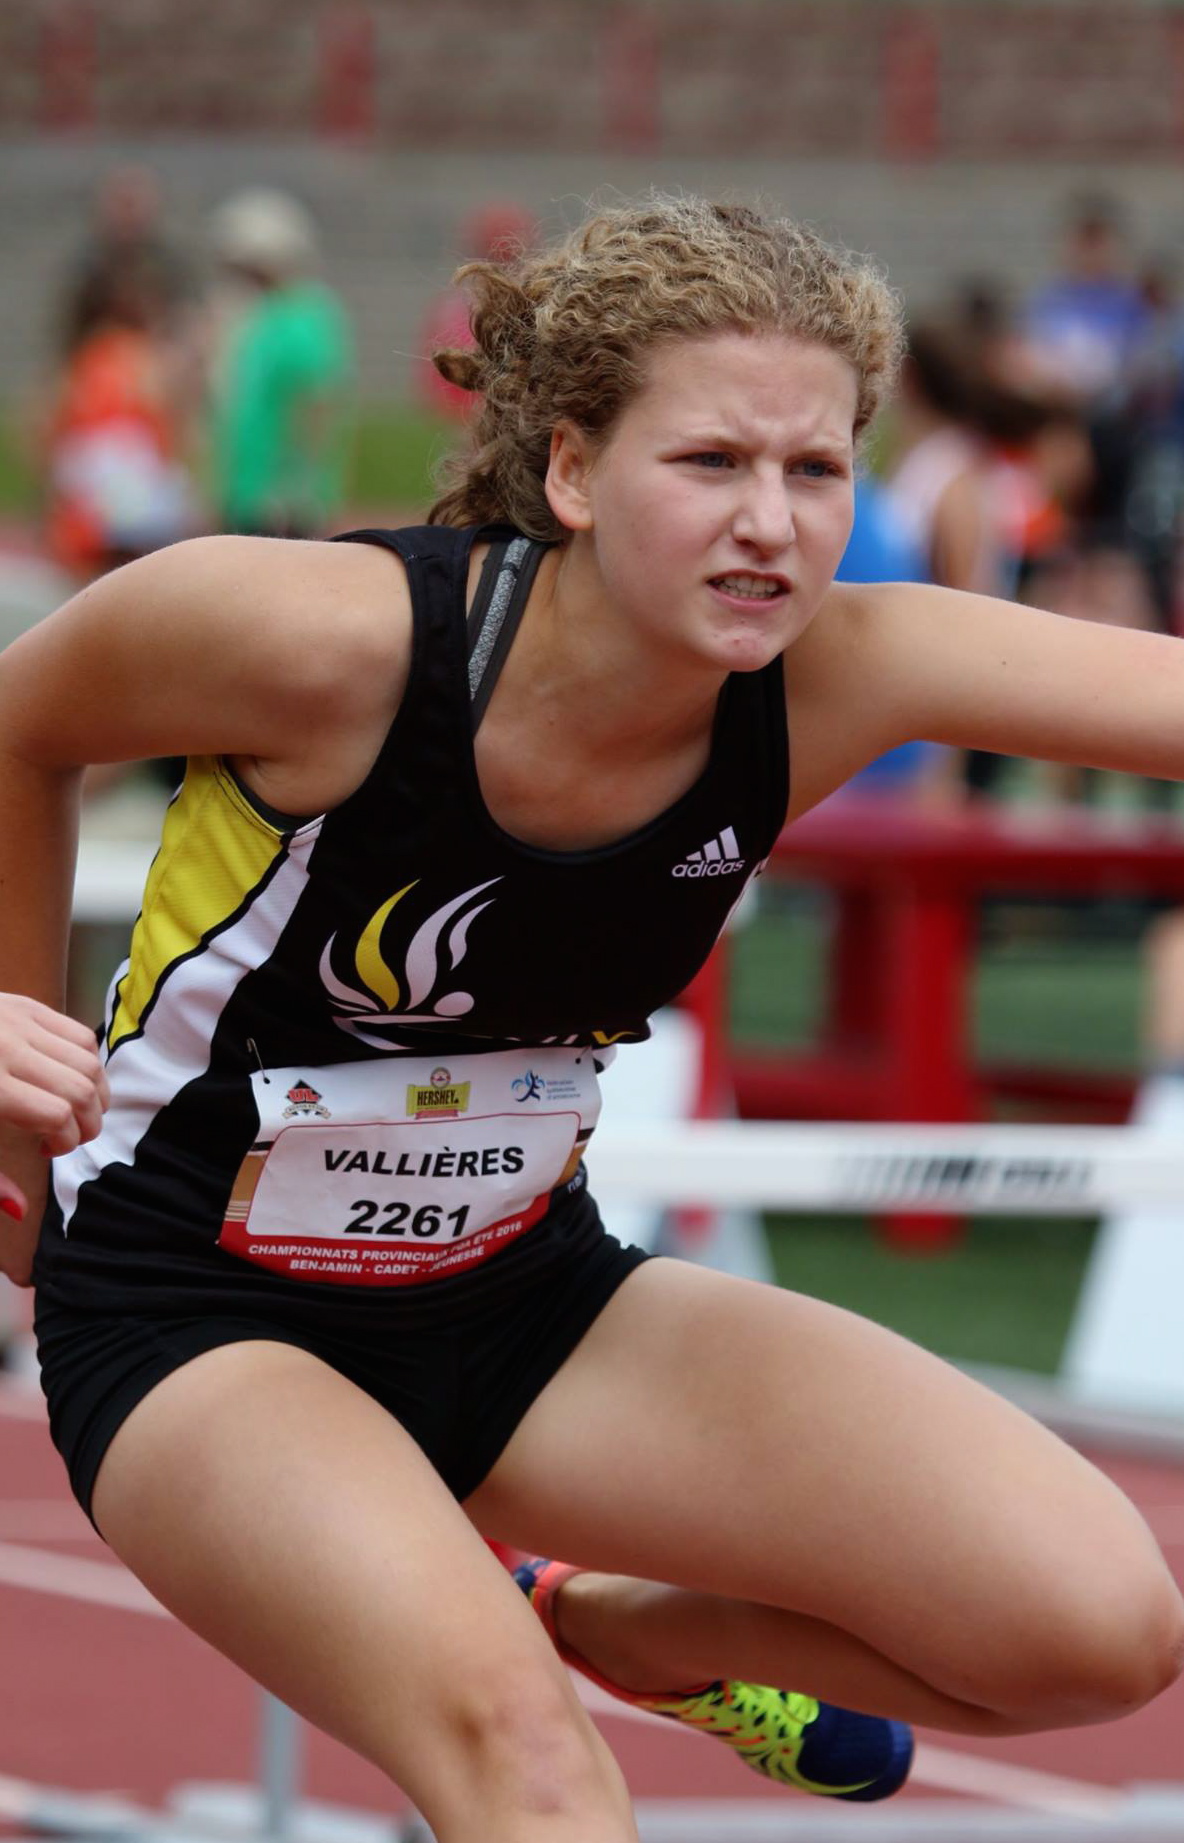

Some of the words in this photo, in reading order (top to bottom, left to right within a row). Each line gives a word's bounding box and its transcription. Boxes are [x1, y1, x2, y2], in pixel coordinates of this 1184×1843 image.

[671, 859, 745, 878] adidas
[324, 1146, 524, 1177] VALLIÈRES
[344, 1200, 470, 1237] 2261
[248, 1244, 359, 1260] CHAMPIONNATS
[289, 1259, 362, 1274] BENJAMIN
[374, 1263, 419, 1275] CADET
